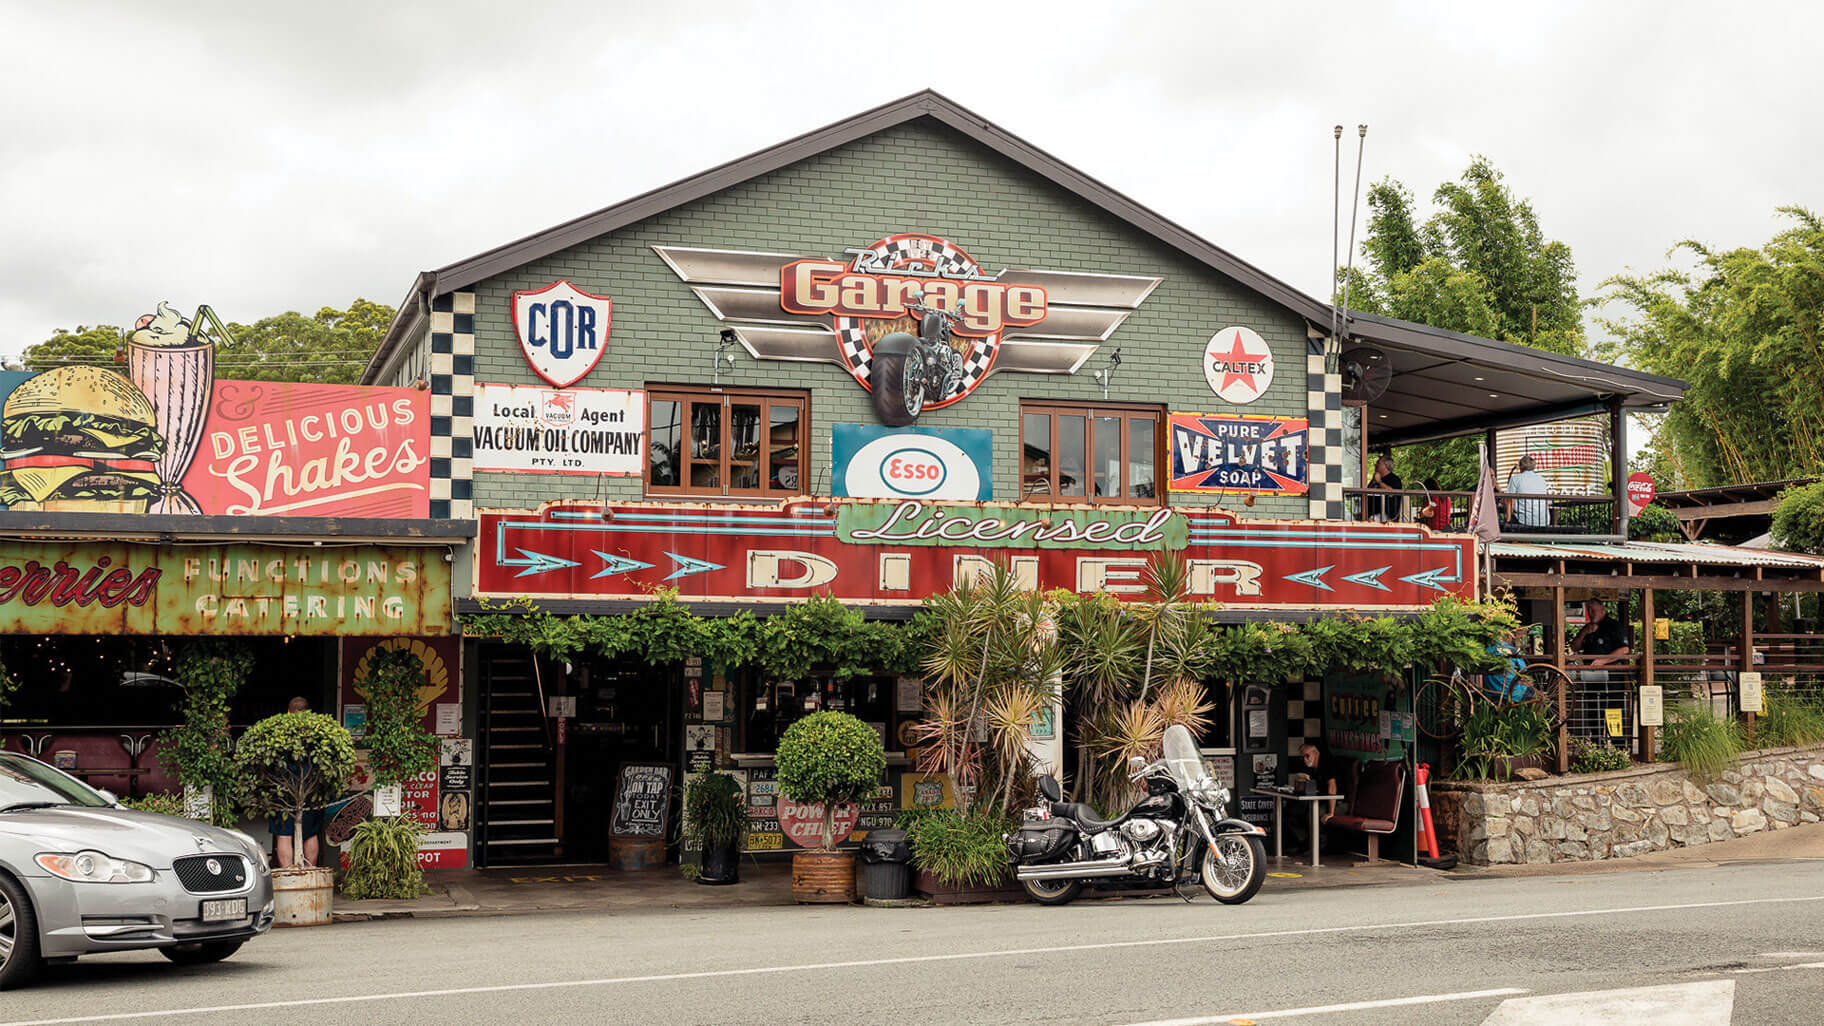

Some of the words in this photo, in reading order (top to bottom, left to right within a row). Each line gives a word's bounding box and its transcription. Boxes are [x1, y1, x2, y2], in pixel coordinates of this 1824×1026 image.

[795, 262, 1045, 331] Garage
[528, 300, 598, 360] COR
[1212, 361, 1267, 375] CALTEX
[215, 384, 263, 422] &
[493, 403, 536, 419] Local
[580, 407, 625, 426] Agent
[210, 398, 415, 460] DELICIOUS
[1218, 424, 1260, 438] PURE
[473, 425, 539, 452] VACUUM
[544, 428, 569, 452] OIL
[571, 429, 641, 455] COMPANY
[1176, 431, 1304, 474] VELVET
[208, 438, 426, 516] Shakes
[889, 459, 940, 479] Esso
[1219, 470, 1262, 484] SOAP
[850, 501, 1173, 543] Licensed
[183, 558, 417, 584] FUNCTIONS
[746, 549, 1263, 596] DINER
[0, 556, 163, 608] erries
[194, 595, 405, 619] CATERING
[406, 771, 437, 782] ACO
[400, 791, 430, 799] TOR
[632, 782, 643, 793] ON
[646, 782, 664, 794] TAP
[632, 809, 661, 819] ONLY
[634, 800, 657, 809] EXIT
[782, 804, 856, 819] POWR-
[413, 852, 441, 863] POT
